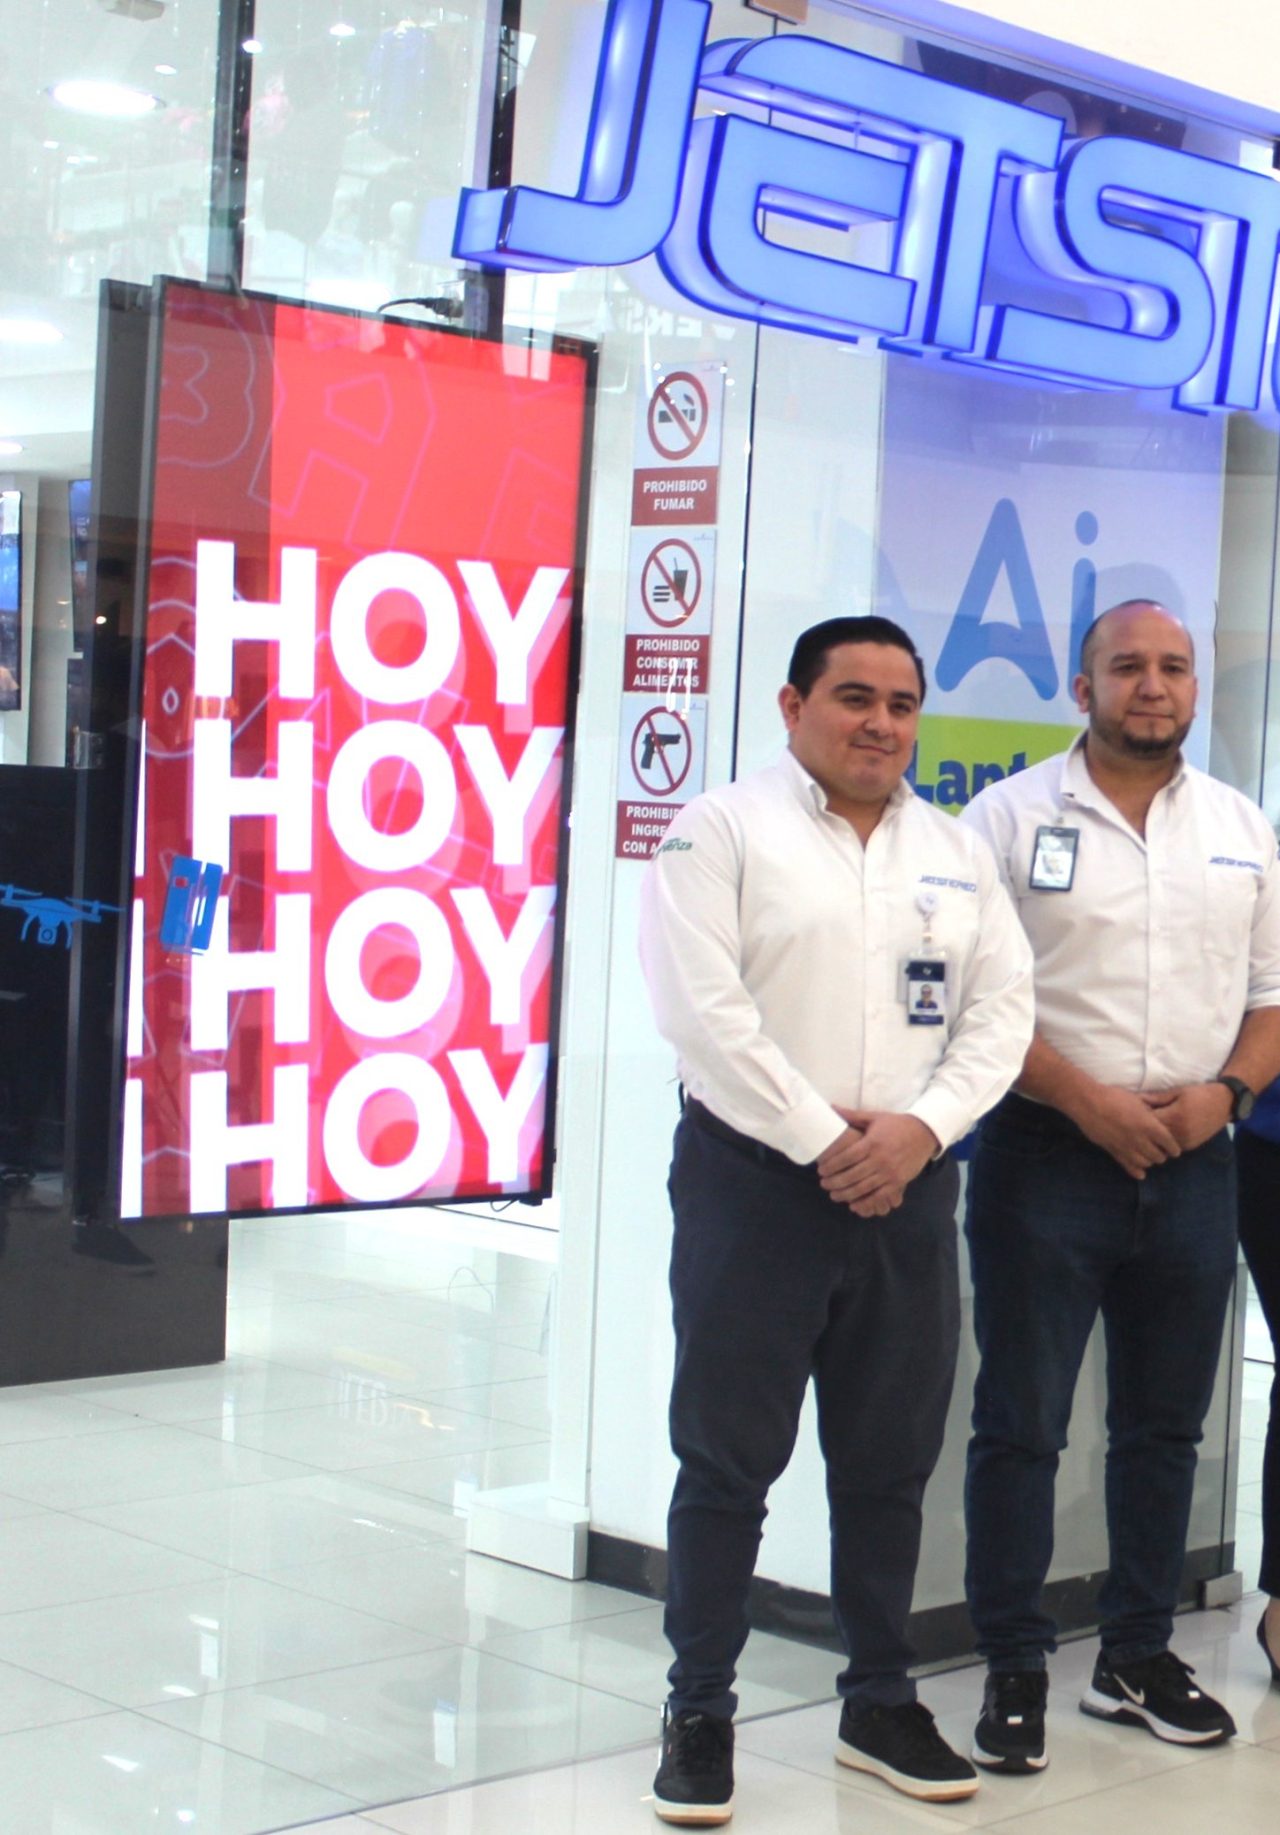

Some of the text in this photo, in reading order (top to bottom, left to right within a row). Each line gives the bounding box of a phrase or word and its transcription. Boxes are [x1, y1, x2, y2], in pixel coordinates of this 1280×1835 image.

[642, 479, 708, 494] PROHIBIDO
[653, 497, 696, 511] FUMAR
[194, 539, 571, 705] HOY
[636, 638, 701, 652] PROHIBIDO
[192, 717, 566, 875] HOY
[622, 840, 647, 854] CON
[190, 884, 558, 1051] HOY
[189, 1042, 550, 1216] HOY
